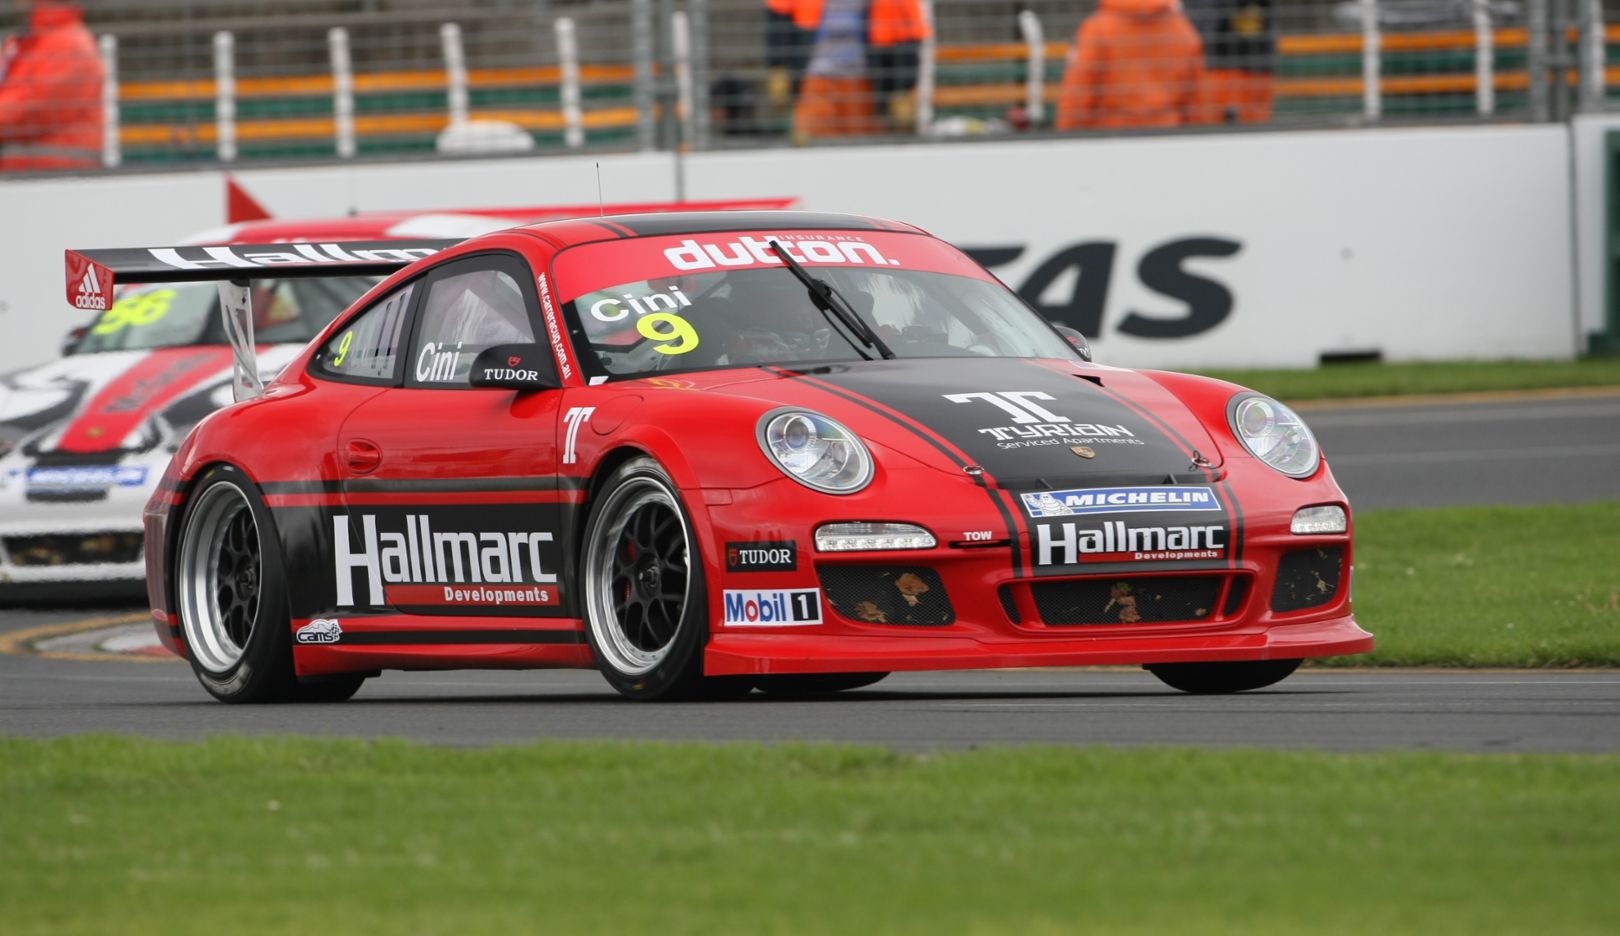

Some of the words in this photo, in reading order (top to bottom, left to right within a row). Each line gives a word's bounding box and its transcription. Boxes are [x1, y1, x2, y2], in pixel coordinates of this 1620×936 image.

[779, 234, 865, 243] INSURANCE
[75, 293, 106, 310] adidas
[590, 285, 693, 322] Cini
[538, 272, 572, 380] www.carreracup.com.au
[636, 312, 700, 355] 9
[334, 331, 353, 367] 9
[416, 341, 463, 382] Cini
[484, 369, 538, 381] TUDOR
[996, 437, 1060, 450] Serviced
[1063, 436, 1145, 446] Apartments
[1065, 491, 1209, 506] MICHELIN
[963, 530, 992, 541] TOW
[1037, 521, 1224, 565] Hallmarc
[333, 514, 557, 606] Hallmarc
[739, 549, 792, 564] TUDOR
[1134, 549, 1218, 560] Developments
[444, 586, 549, 604] Developments
[725, 592, 787, 623] Mobil
[796, 594, 809, 620] 1
